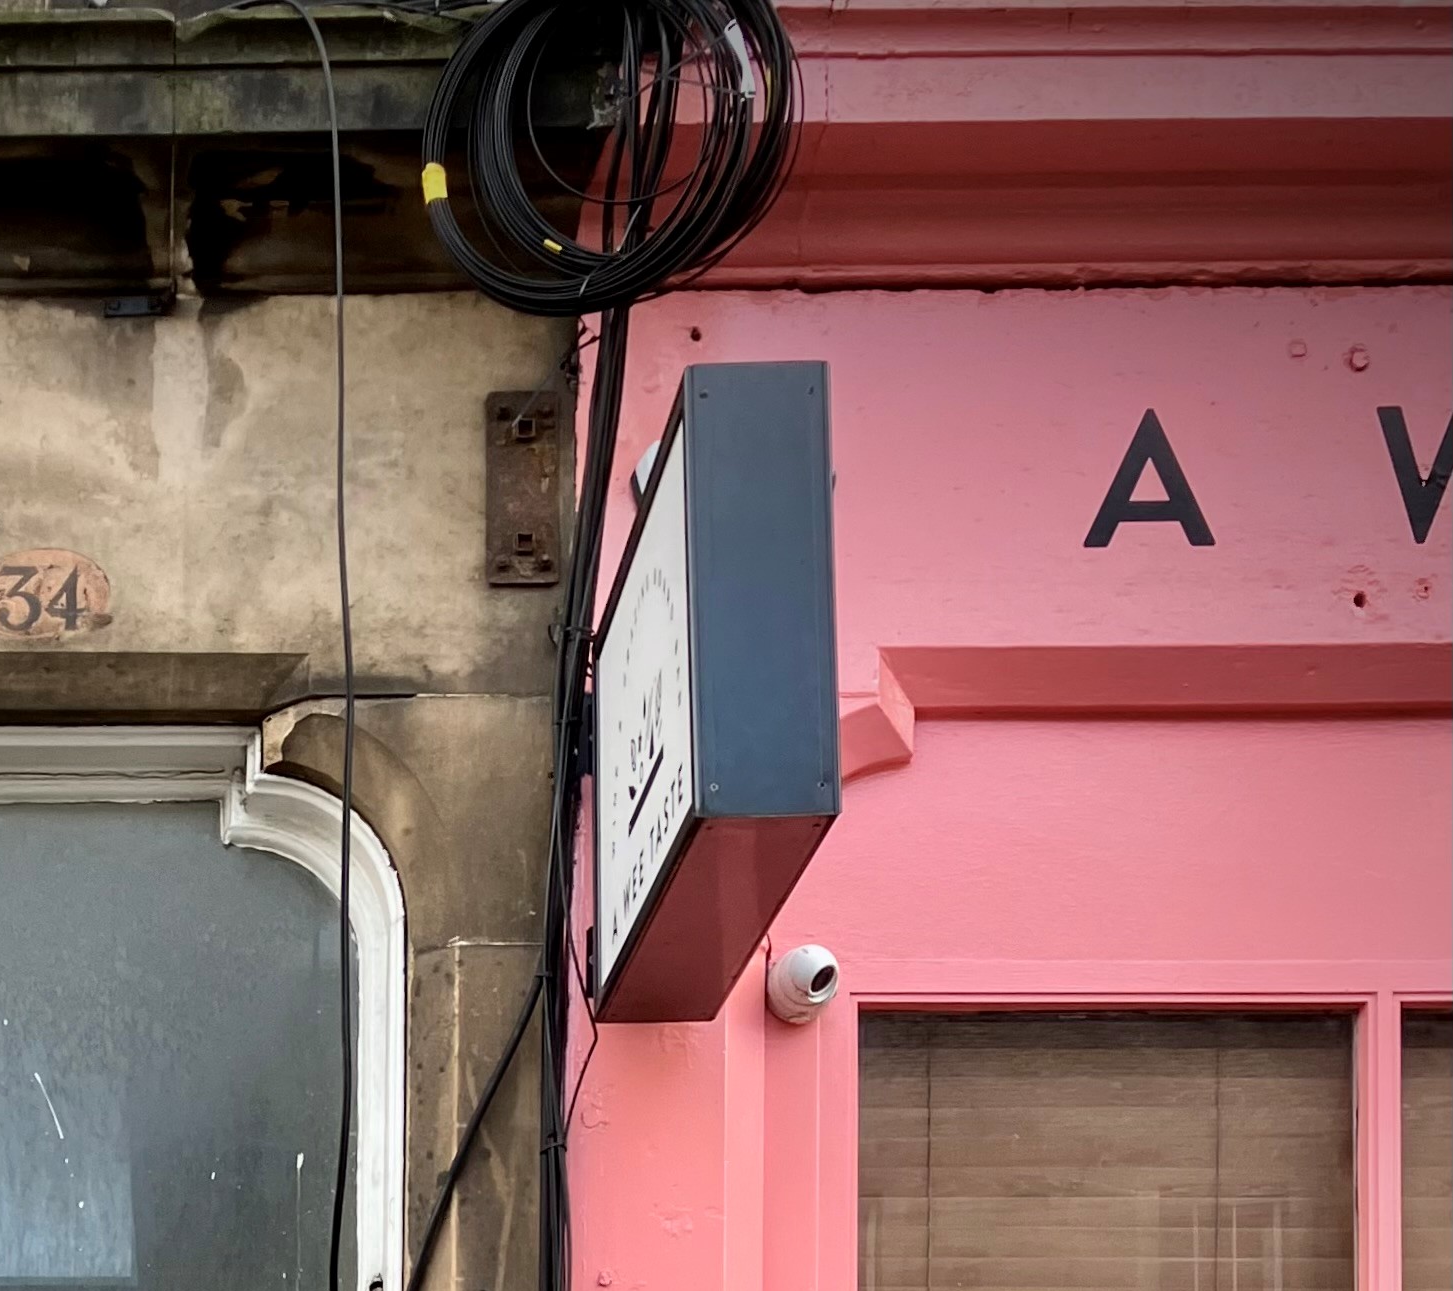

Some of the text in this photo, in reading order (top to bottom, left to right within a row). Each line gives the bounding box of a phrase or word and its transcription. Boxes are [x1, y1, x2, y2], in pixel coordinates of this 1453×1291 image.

[1083, 408, 1216, 547] A
[612, 762, 683, 944] A WEE TASTE
